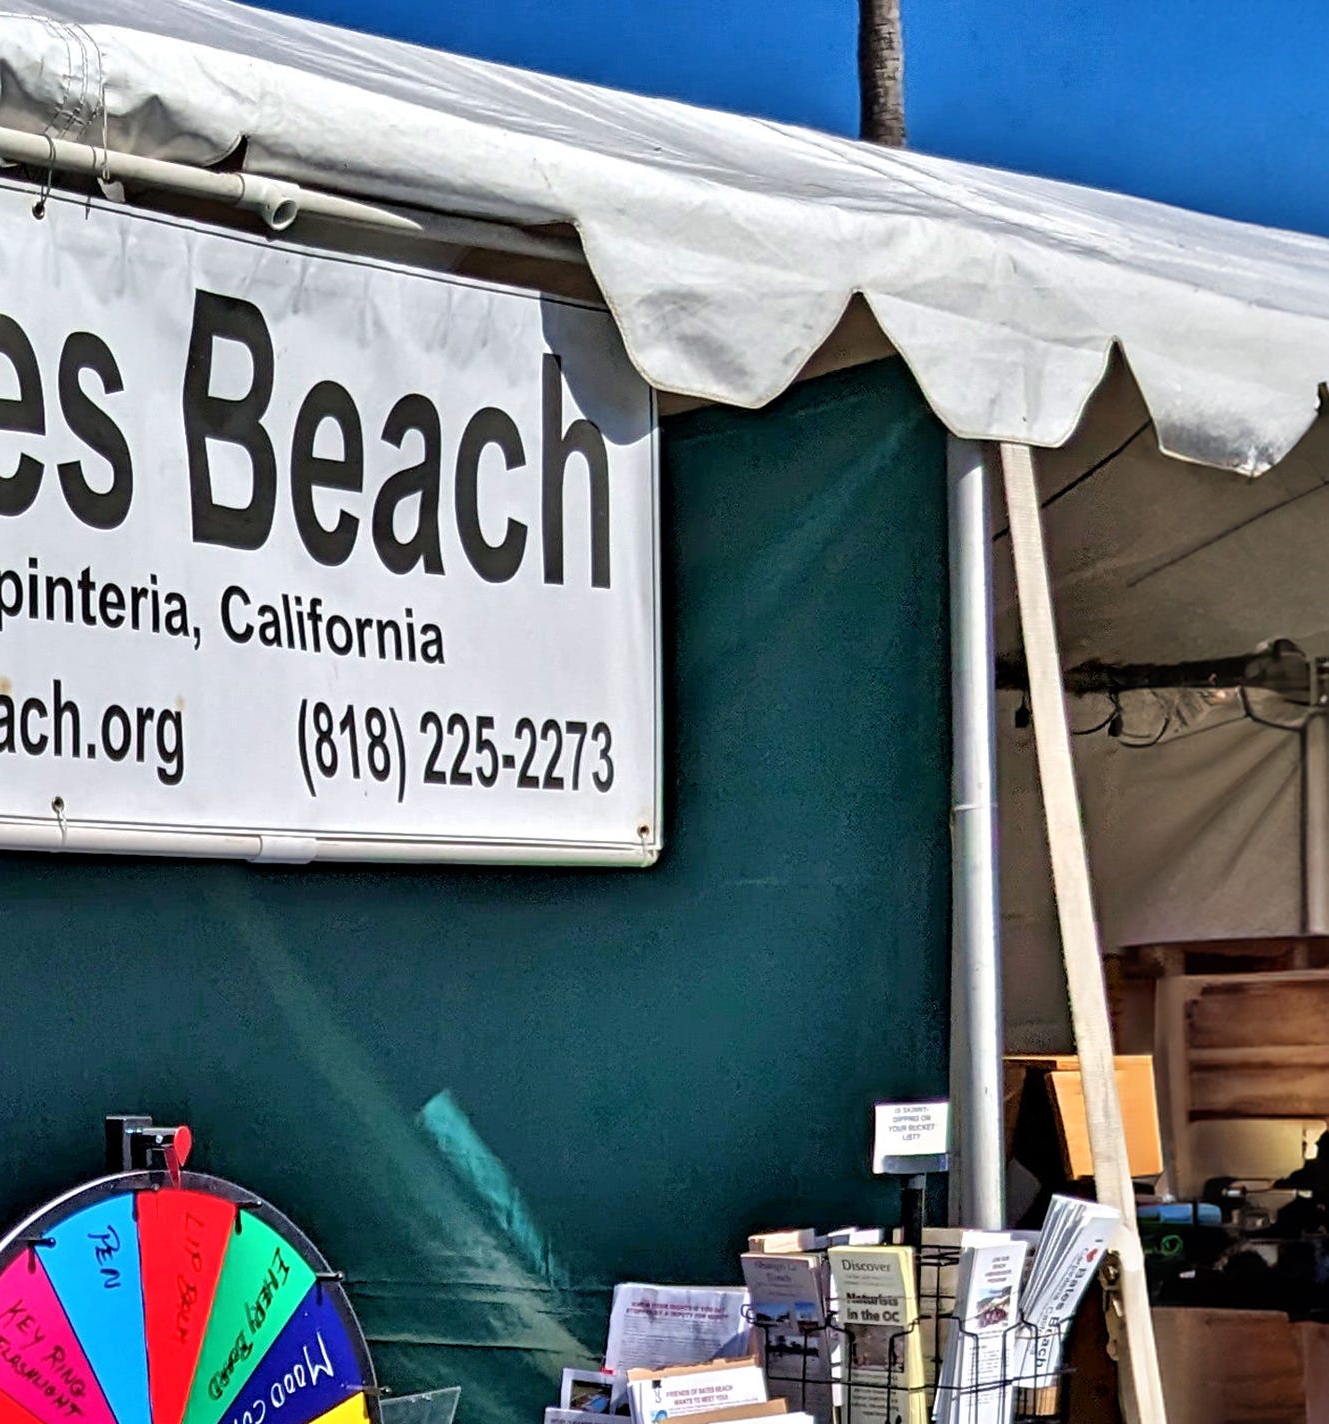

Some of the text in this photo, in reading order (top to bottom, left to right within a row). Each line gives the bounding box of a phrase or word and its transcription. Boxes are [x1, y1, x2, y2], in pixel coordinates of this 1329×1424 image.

[184, 289, 611, 588] Beach
[220, 589, 446, 664] California
[295, 694, 408, 801] (818)
[423, 710, 615, 793] 225-2273
[87, 1225, 121, 1289] PEN
[842, 1258, 892, 1273] Discover
[846, 1292, 899, 1307] Naturists
[847, 1308, 900, 1322] in the OC
[41, 1345, 86, 1398] RING
[270, 1331, 334, 1408] MOOD
